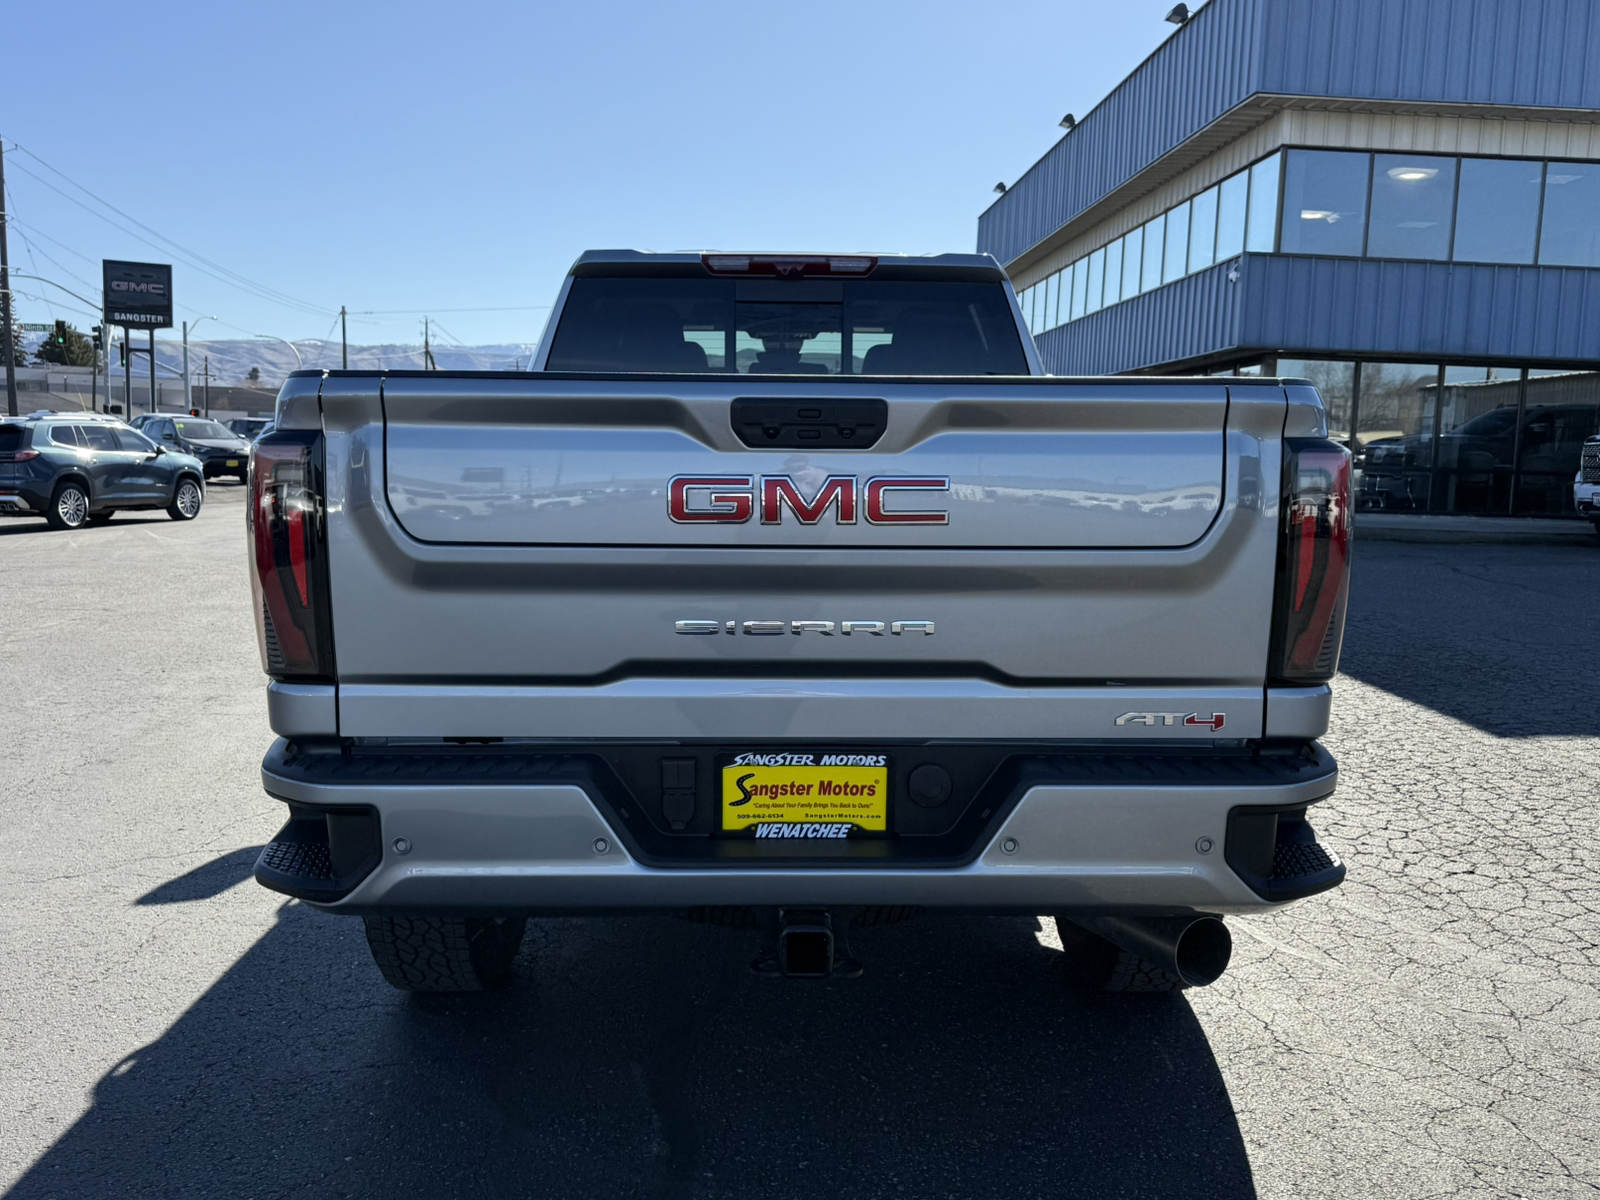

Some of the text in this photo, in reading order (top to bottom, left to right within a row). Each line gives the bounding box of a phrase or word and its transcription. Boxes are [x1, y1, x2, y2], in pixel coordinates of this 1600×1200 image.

[111, 281, 164, 294] GMC
[114, 312, 164, 323] SANGSTER
[667, 474, 950, 526] GMC
[674, 620, 936, 636] SIERRA
[1114, 712, 1226, 732] AT4
[724, 752, 887, 768] SANGSTER MOTORS
[728, 773, 814, 807] Sangster
[755, 823, 852, 838] WENATCHEE
